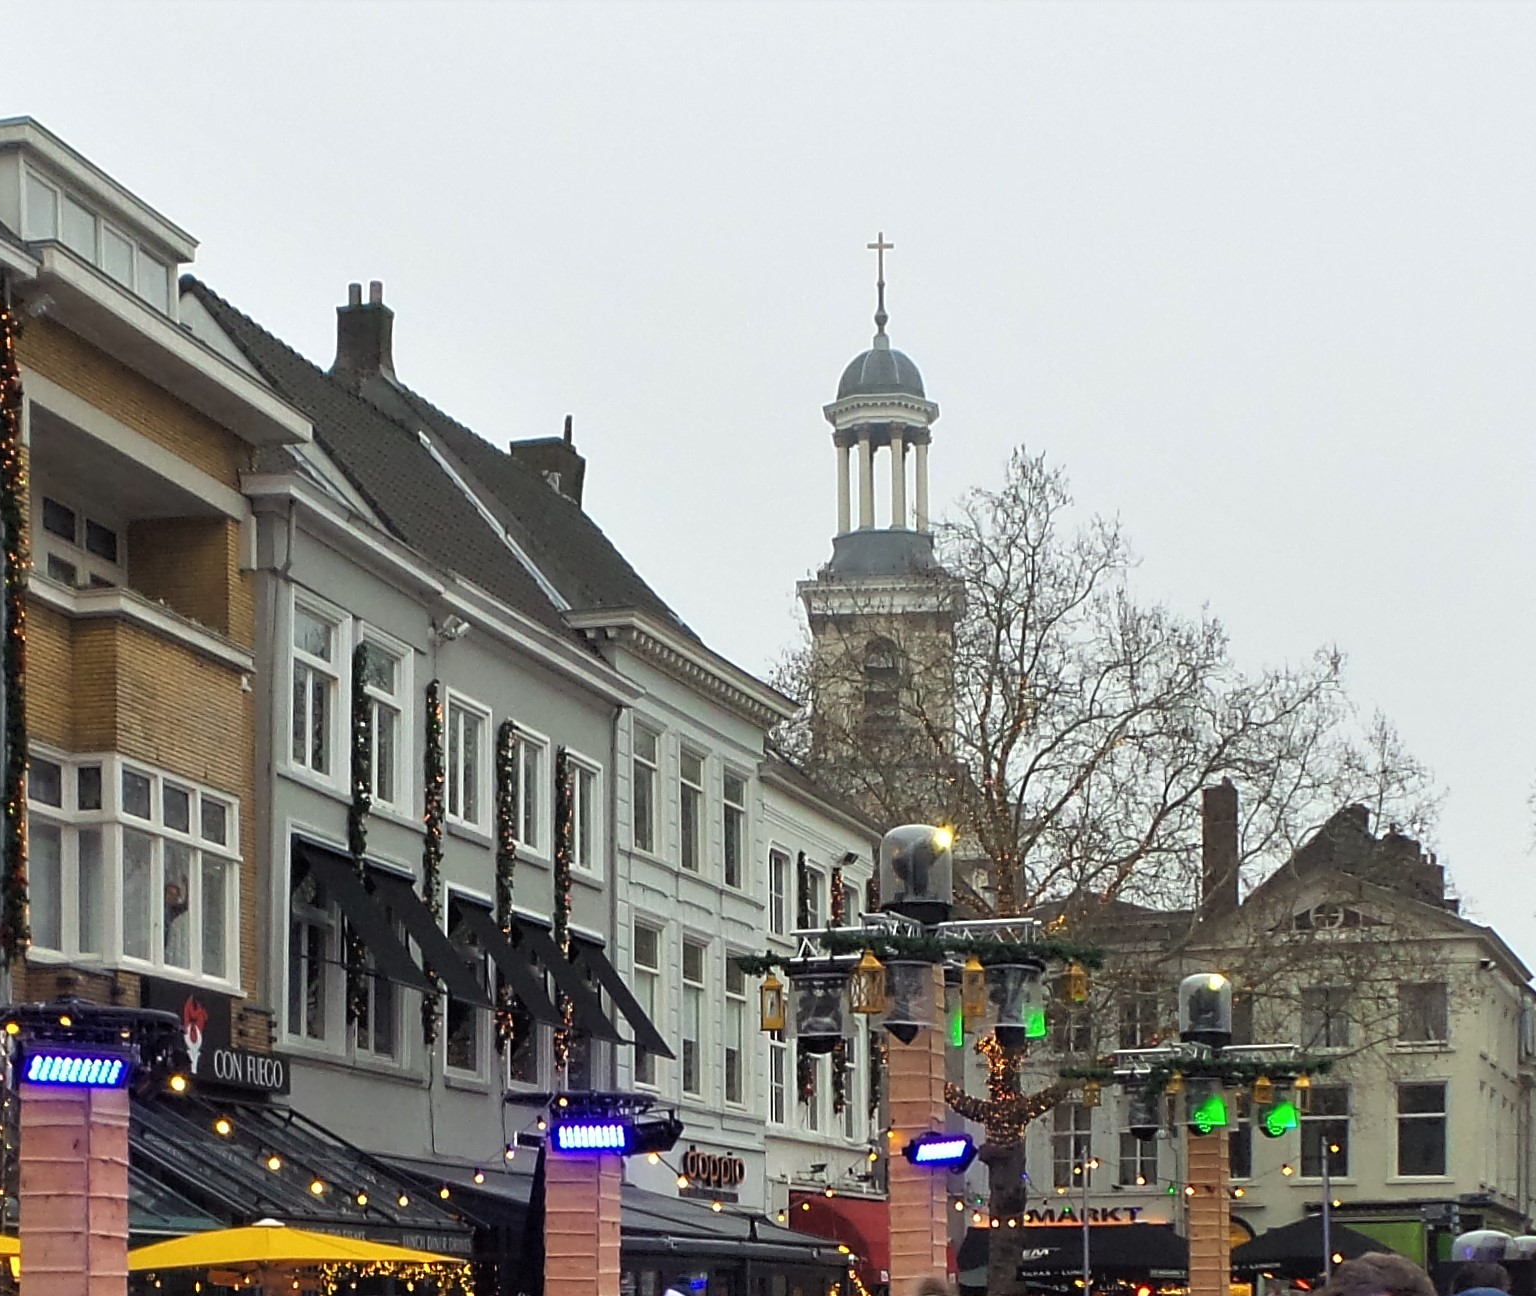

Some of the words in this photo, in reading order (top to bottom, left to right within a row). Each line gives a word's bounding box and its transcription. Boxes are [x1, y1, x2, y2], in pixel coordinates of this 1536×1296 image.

[214, 1050, 242, 1081] CON
[246, 1055, 284, 1087] FUEGO
[683, 1145, 747, 1188] doppio
[1026, 1207, 1143, 1223] MARKT
